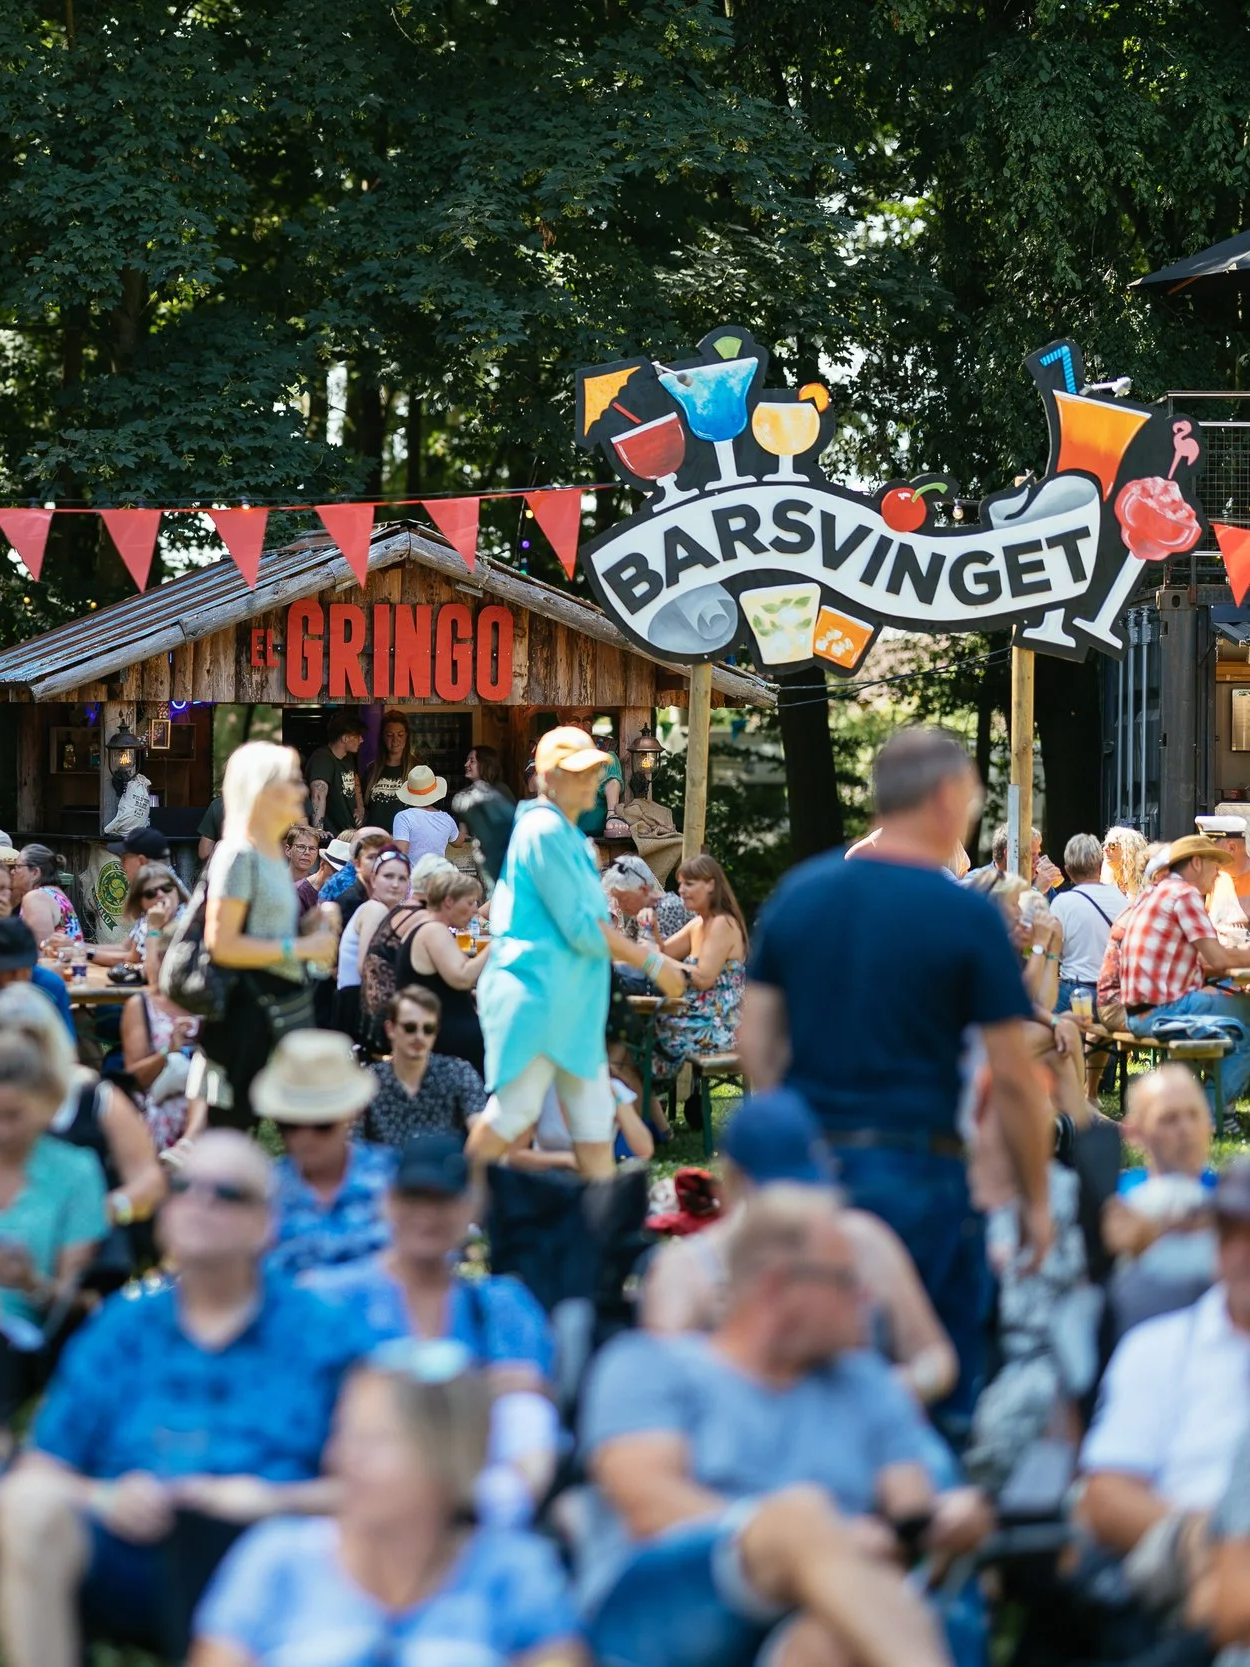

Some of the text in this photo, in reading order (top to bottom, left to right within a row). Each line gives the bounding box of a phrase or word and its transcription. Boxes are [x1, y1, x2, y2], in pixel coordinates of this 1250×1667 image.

[602, 499, 1093, 615] BARSVINGET
[251, 599, 514, 702] EL GRINGO
